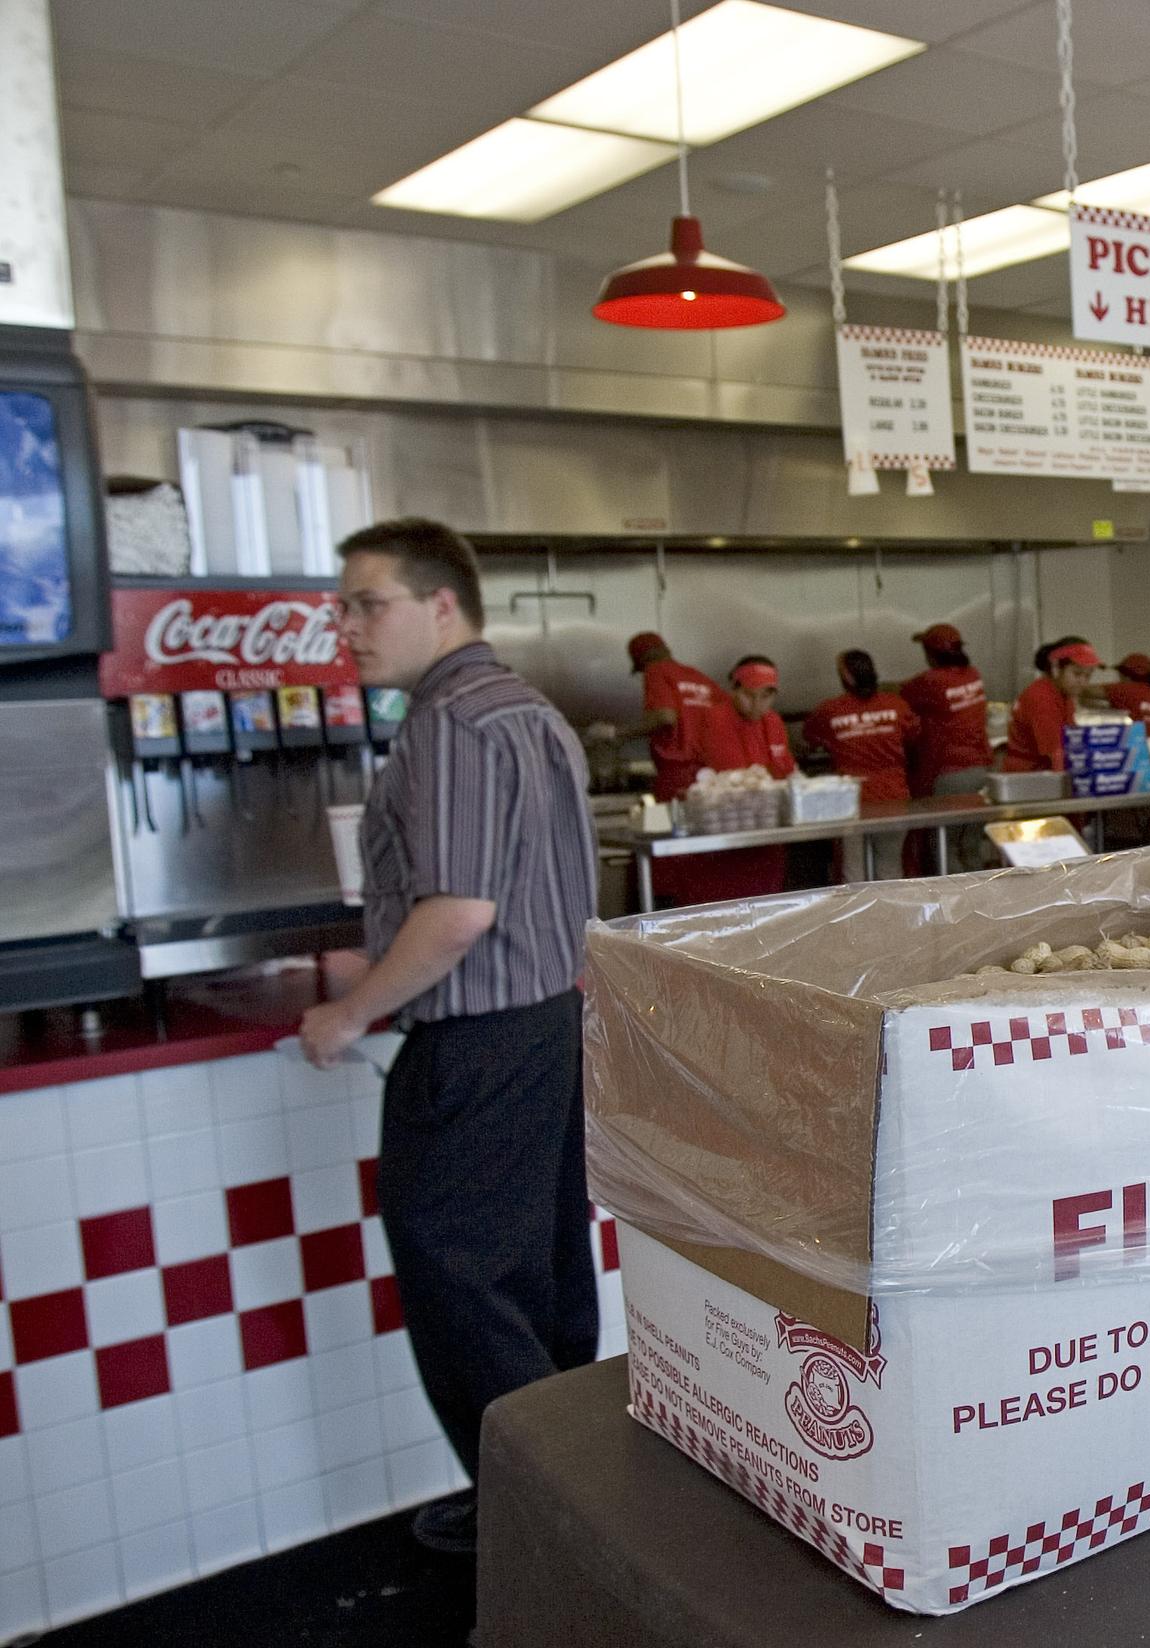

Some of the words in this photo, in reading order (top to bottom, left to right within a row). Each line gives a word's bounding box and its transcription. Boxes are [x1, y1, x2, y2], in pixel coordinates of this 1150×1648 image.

[145, 599, 338, 665] Coca-Cola
[215, 668, 285, 689] CLASSIC
[643, 1315, 664, 1345] SHELL
[665, 1333, 700, 1372] PEANUTS
[705, 1299, 730, 1325] Packed
[731, 1318, 771, 1351] exclusively
[705, 1315, 715, 1330] for
[715, 1322, 730, 1341] Five
[731, 1332, 749, 1354] Guys
[1029, 1334, 1098, 1376] DUE
[1107, 1321, 1149, 1354] TO
[719, 1341, 734, 1361] Cox
[735, 1351, 771, 1386] Company
[637, 1334, 647, 1357] TO
[647, 1346, 691, 1394] POSSIBLE
[693, 1384, 743, 1433] ALLERGIC
[747, 1421, 820, 1483] REACTIONS
[791, 1396, 865, 1450] PEANUTS
[953, 1380, 1087, 1434] PLEASE
[1098, 1365, 1142, 1400] DO
[651, 1373, 663, 1395] DO
[665, 1386, 683, 1411] NOT
[686, 1402, 727, 1448] REMOVE
[730, 1436, 784, 1489] PEANUTS
[786, 1475, 826, 1517] FROM
[831, 1503, 904, 1540] STORE
